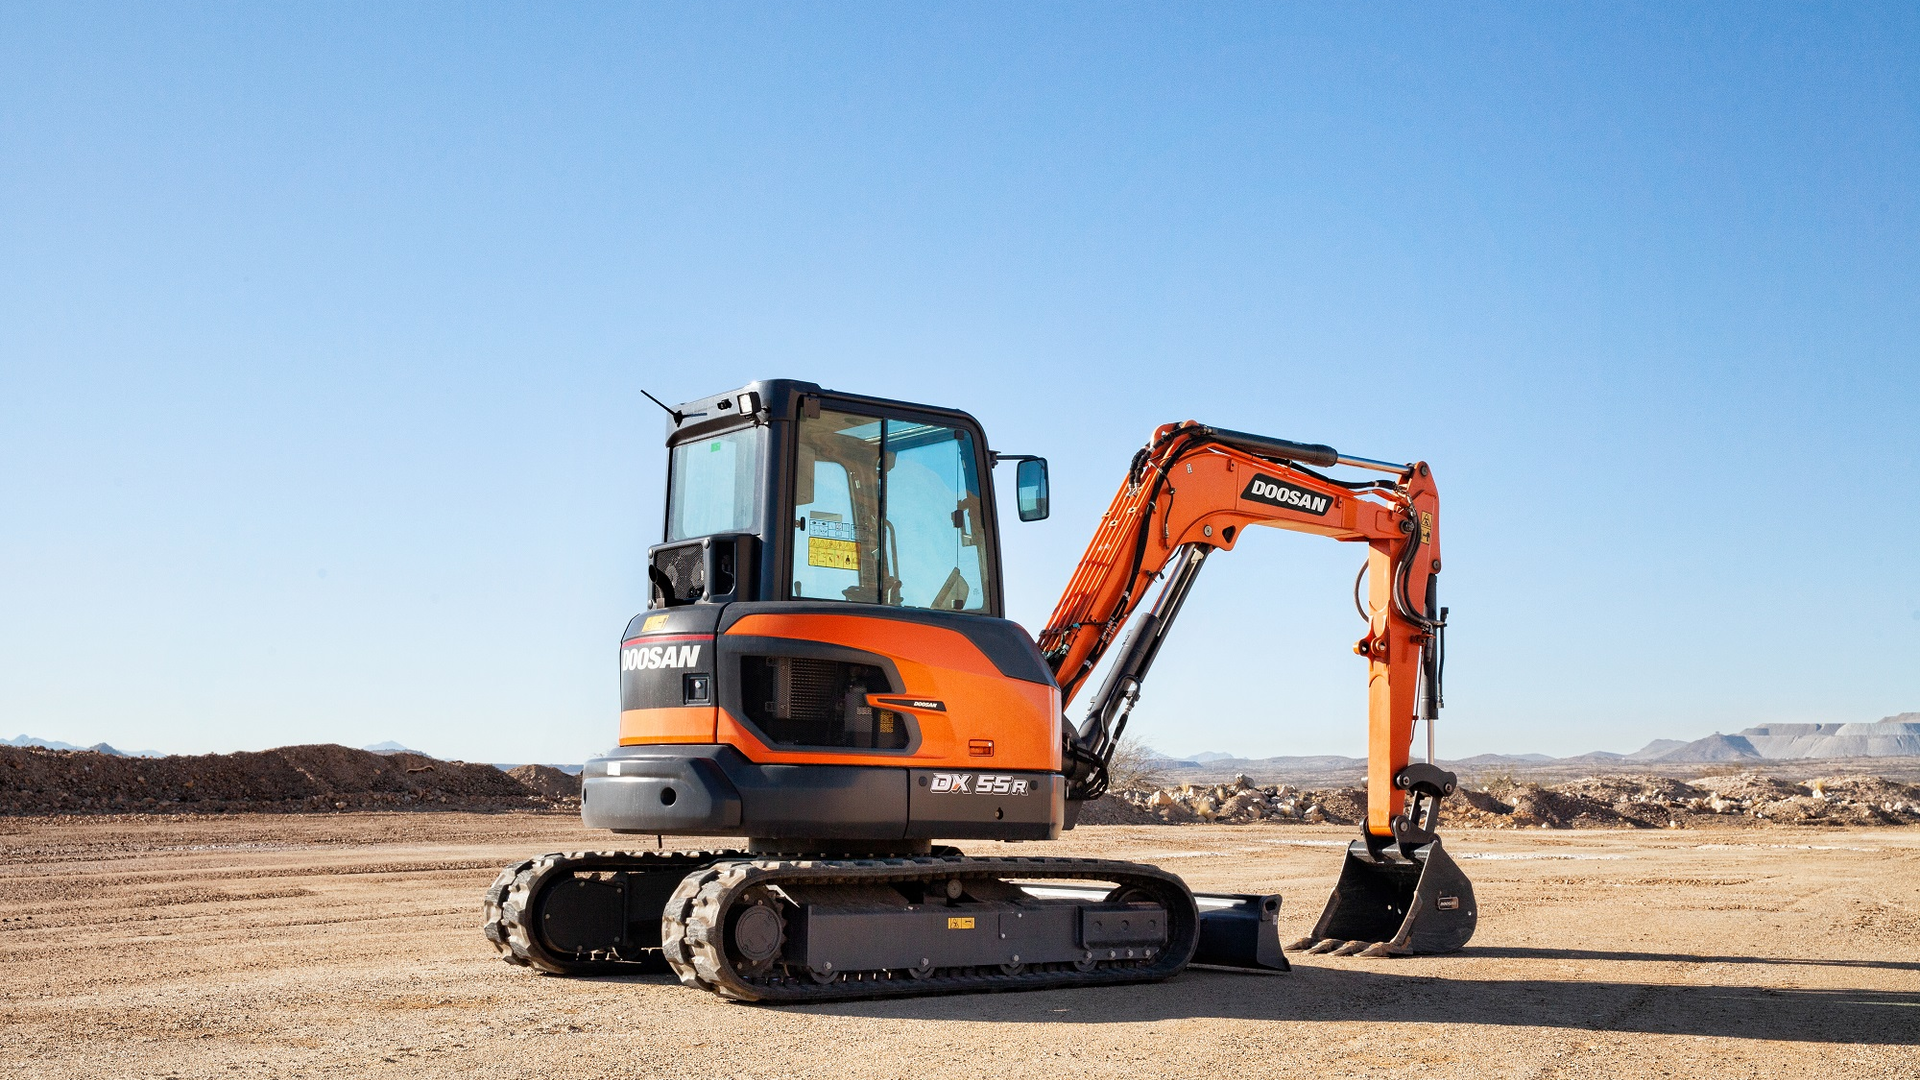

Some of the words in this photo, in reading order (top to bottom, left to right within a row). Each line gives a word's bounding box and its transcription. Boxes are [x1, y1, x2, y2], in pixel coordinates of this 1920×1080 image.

[1251, 480, 1327, 513] DOOSAN
[622, 645, 701, 671] DOOSAN
[930, 773, 972, 794] DX
